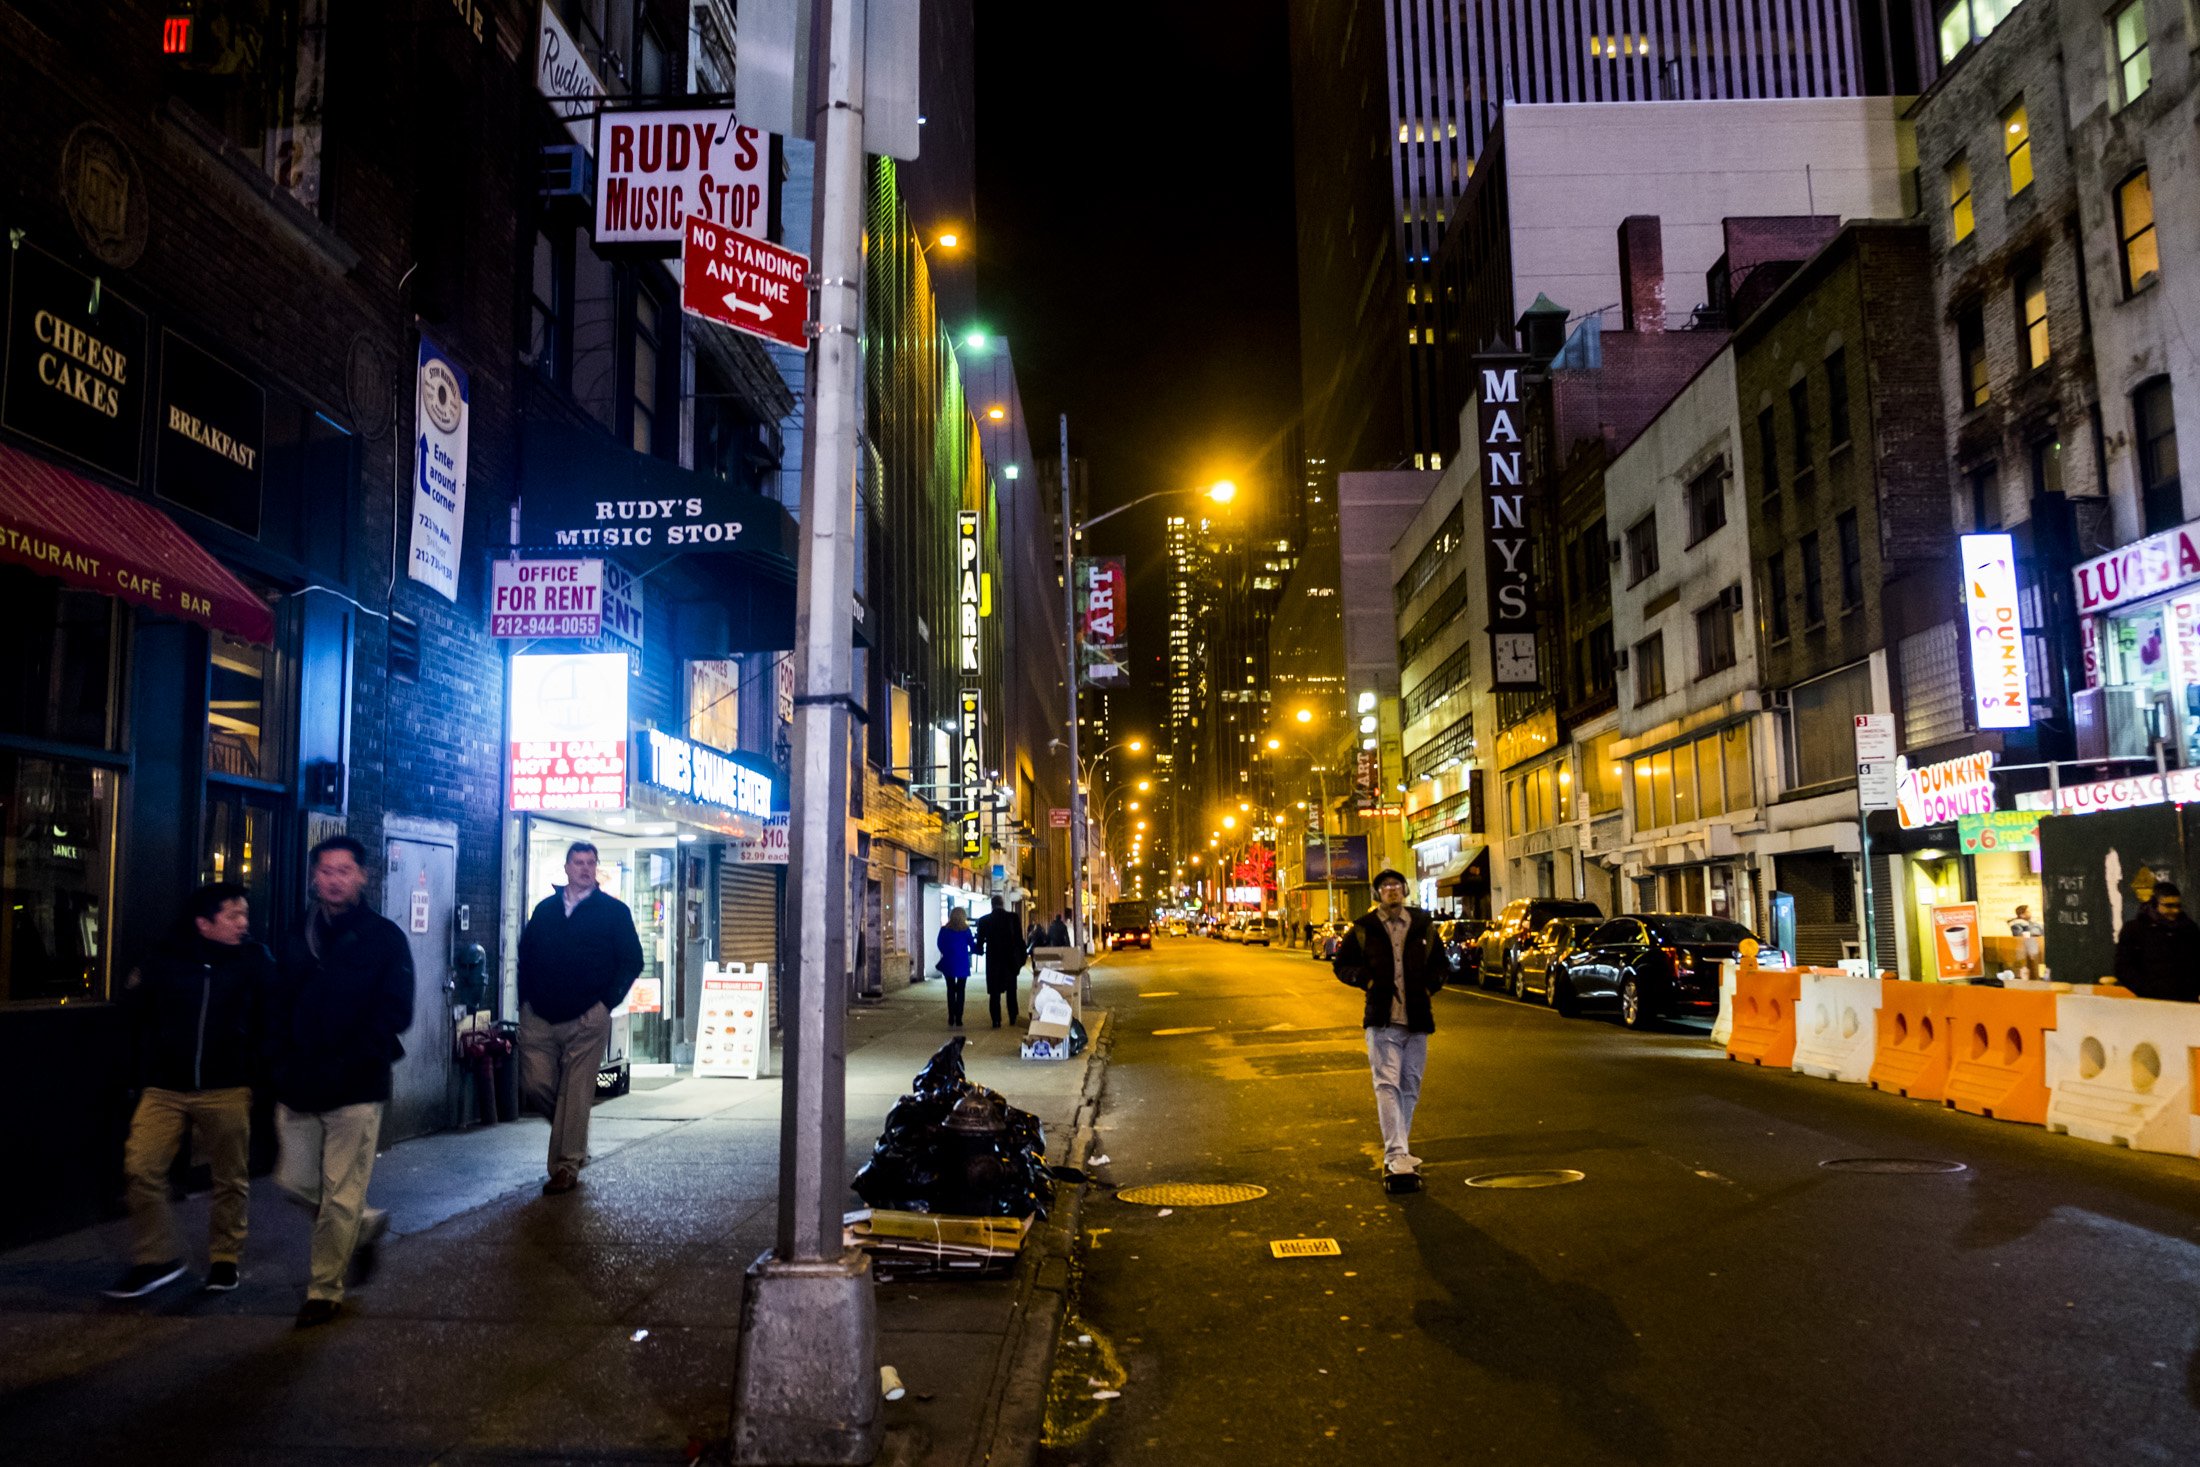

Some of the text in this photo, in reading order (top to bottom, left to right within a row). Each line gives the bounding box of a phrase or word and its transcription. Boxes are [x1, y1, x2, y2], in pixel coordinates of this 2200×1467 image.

[610, 121, 759, 173] RUDY'S
[605, 173, 761, 232] MUSIC STOP
[693, 225, 802, 283] NO STANDING
[705, 259, 790, 305] ANYTIME
[34, 309, 127, 386] CHEESE
[38, 353, 119, 419] CAKES
[168, 405, 257, 471] BREAKFAST
[433, 443, 454, 471] Enter
[430, 466, 457, 496] around
[431, 487, 456, 514] corner
[1482, 368, 1527, 620] MANNY'S
[595, 497, 703, 521] RUDY'S
[556, 522, 743, 548] MUSIC STOP
[117, 567, 162, 601] CAFÉ
[180, 590, 212, 617] BAR
[518, 566, 579, 583] OFFICE
[496, 584, 597, 612] FOR RENT
[961, 537, 978, 670] PARK
[1089, 566, 1115, 638] ART
[495, 615, 597, 637] 212-944-0055
[603, 597, 643, 648] ENT
[1995, 607, 2023, 715] DUNKIN'
[512, 757, 624, 775] HOT & COLD
[650, 728, 772, 820] TIMES SQUARE EATERY
[962, 713, 979, 812] FAST
[1861, 764, 1869, 775] 6
[1920, 753, 1991, 794] DUNKIN'
[1923, 785, 1992, 823] DONUTS
[2060, 773, 2187, 810] LUGGAGE
[740, 850, 766, 861] $2.99
[1980, 829, 1997, 849] 6
[2057, 875, 2086, 890] POST
[2057, 911, 2089, 926] BILLS
